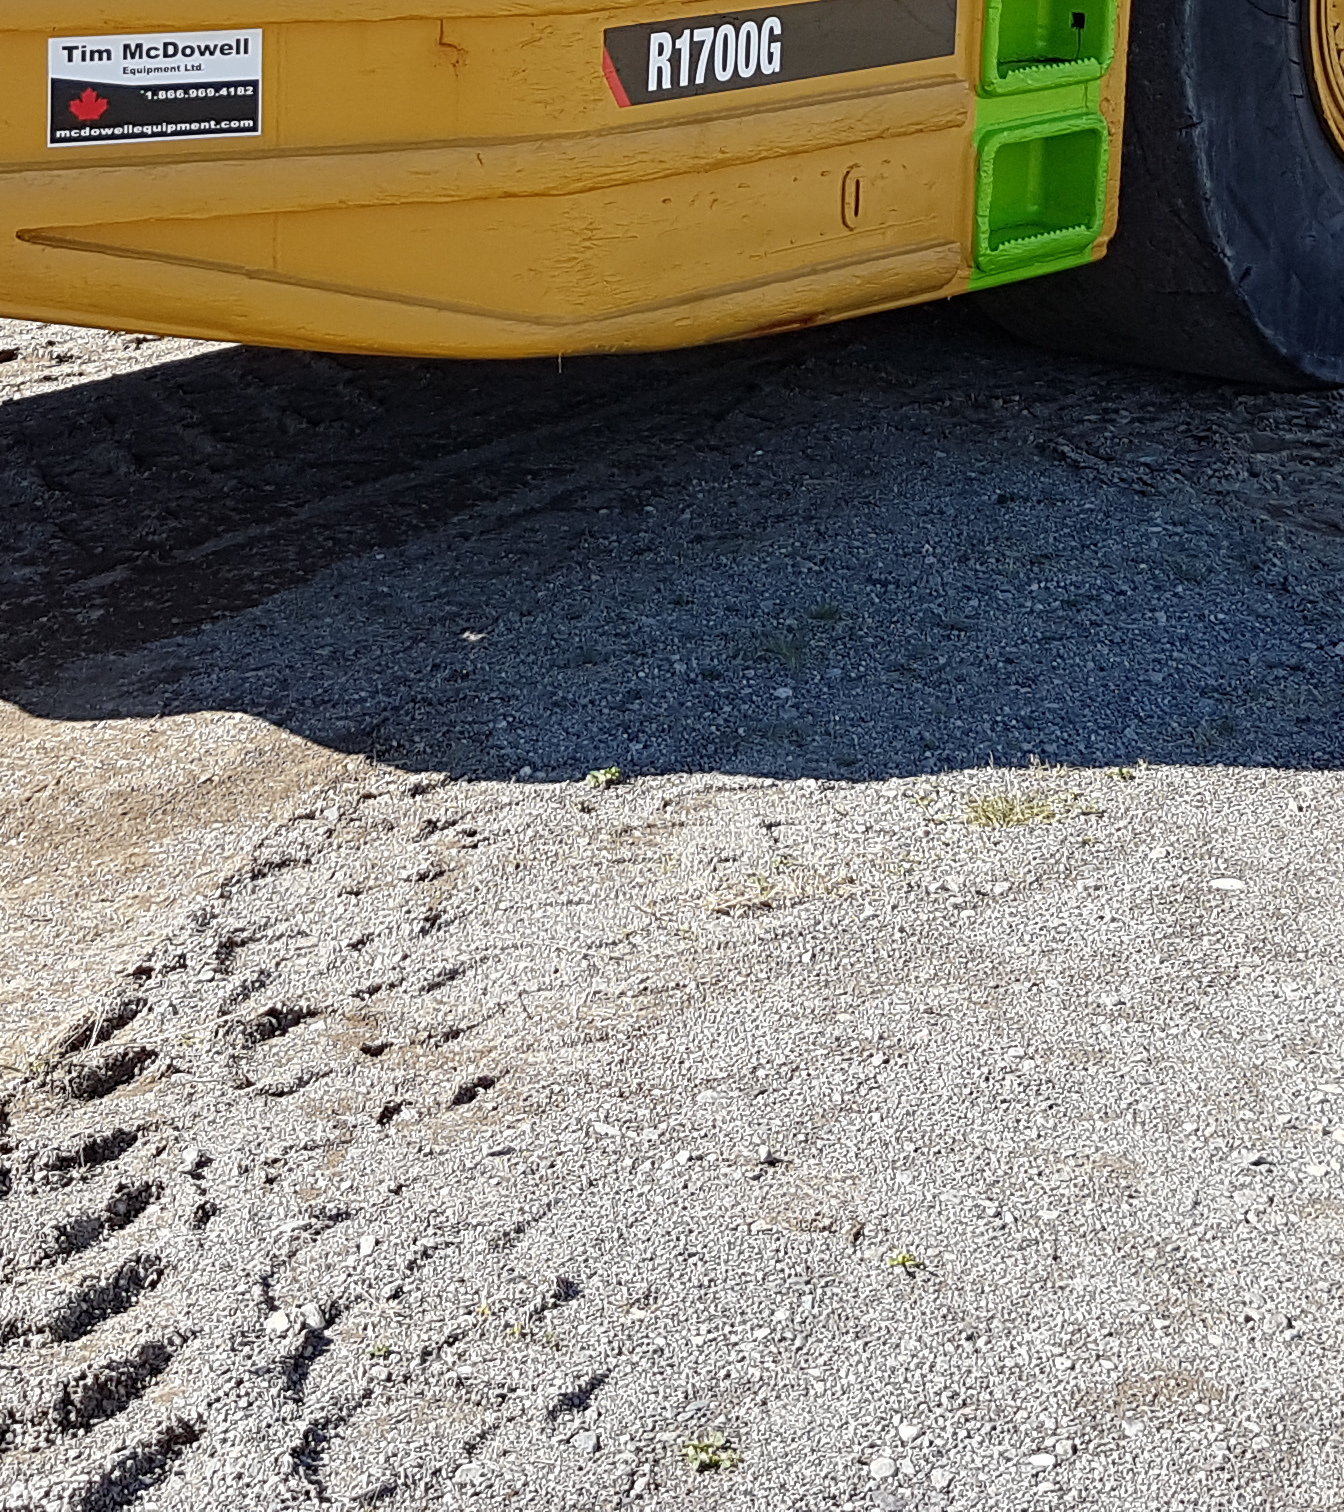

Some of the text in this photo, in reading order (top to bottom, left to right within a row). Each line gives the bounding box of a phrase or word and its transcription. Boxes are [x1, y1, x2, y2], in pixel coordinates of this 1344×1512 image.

[62, 38, 250, 63] Tim McDowell
[647, 16, 782, 92] R1700G
[122, 64, 181, 76] Equipment
[56, 119, 254, 138] mcdowellequipment.com
